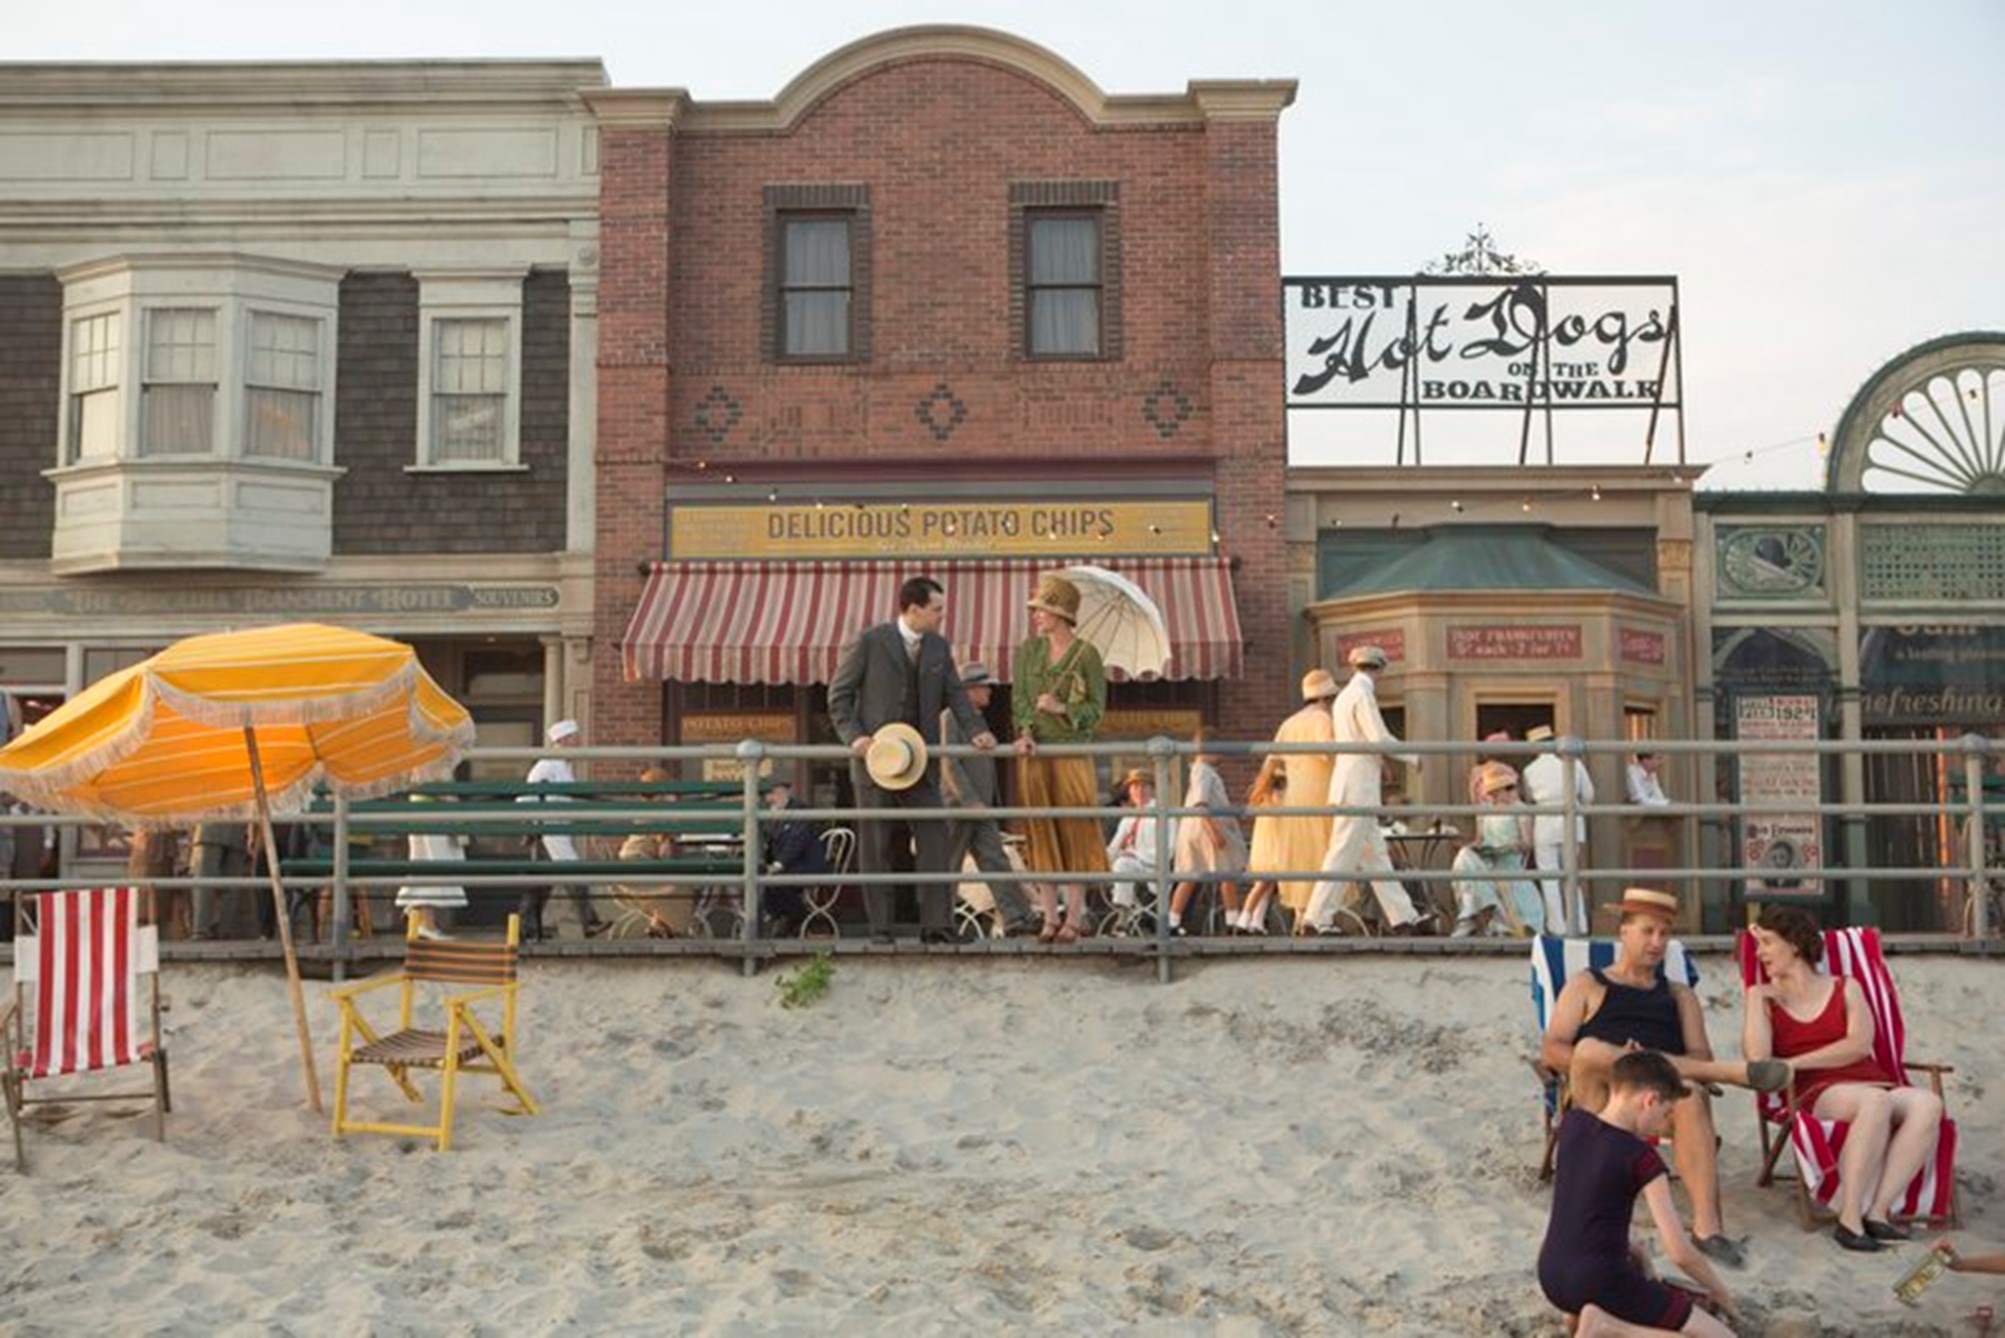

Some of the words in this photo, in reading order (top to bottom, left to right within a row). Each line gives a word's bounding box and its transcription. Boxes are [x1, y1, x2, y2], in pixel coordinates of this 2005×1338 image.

[1300, 285, 1400, 309] BEST
[1292, 303, 1453, 396] Hot
[1459, 284, 1671, 375] Dogs
[1507, 361, 1538, 378] ON
[1552, 361, 1599, 378] THE
[1422, 380, 1661, 402] BOARDWALK
[768, 511, 912, 539] DELICIOUS
[922, 510, 1019, 538] POTATO
[1031, 509, 1115, 538] CHIPS
[380, 588, 456, 610] HOTEL
[474, 588, 554, 607] SOUVENIRS
[1861, 685, 2003, 719] refreshing
